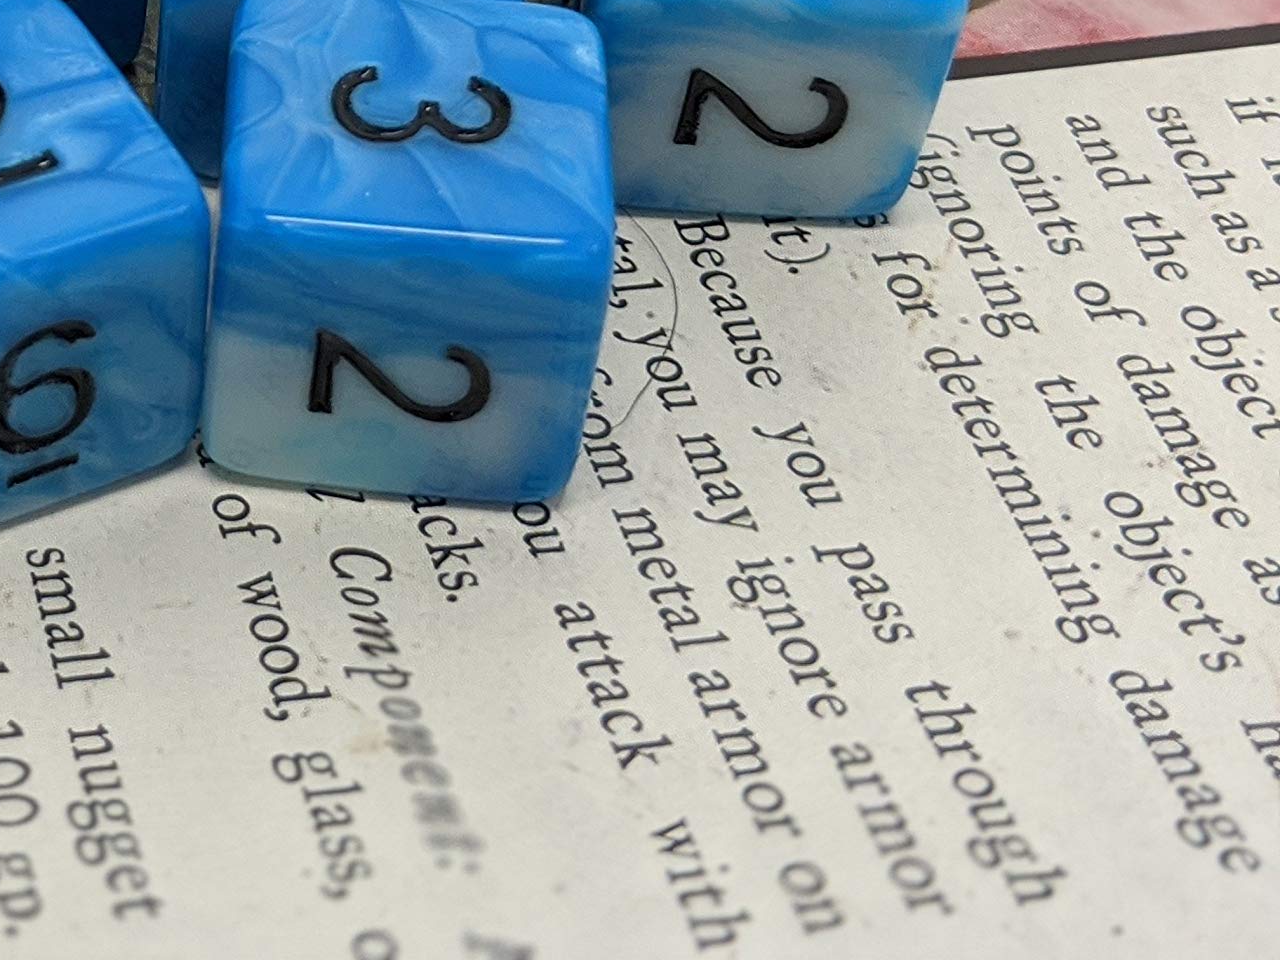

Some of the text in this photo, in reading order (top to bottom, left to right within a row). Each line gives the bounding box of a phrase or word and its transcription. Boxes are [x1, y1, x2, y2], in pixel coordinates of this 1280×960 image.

[329, 64, 513, 145] 3
[673, 68, 849, 150] 2
[1146, 105, 1236, 200] such
[1211, 211, 1264, 253] as
[308, 325, 492, 424] 2
[965, 123, 1084, 255] points
[1074, 280, 1147, 327] of
[1117, 353, 1250, 529] damage
[1065, 114, 1280, 440] and the object
[211, 493, 281, 545] of
[237, 570, 331, 721] wood,
[613, 327, 697, 412] you
[677, 432, 759, 536] may
[728, 554, 850, 720] ignore
[830, 741, 956, 918] armor
[673, 213, 1068, 909] Because you pass through
[872, 251, 1262, 873] for determining damage
[1035, 374, 1103, 450] the
[1104, 491, 1246, 672] object's
[26, 547, 161, 921] small nugget
[271, 750, 373, 901] glass,
[553, 601, 673, 772] attack
[651, 815, 751, 954] with
[613, 506, 731, 654] metal
[688, 669, 803, 840] armor
[778, 859, 846, 937] on
